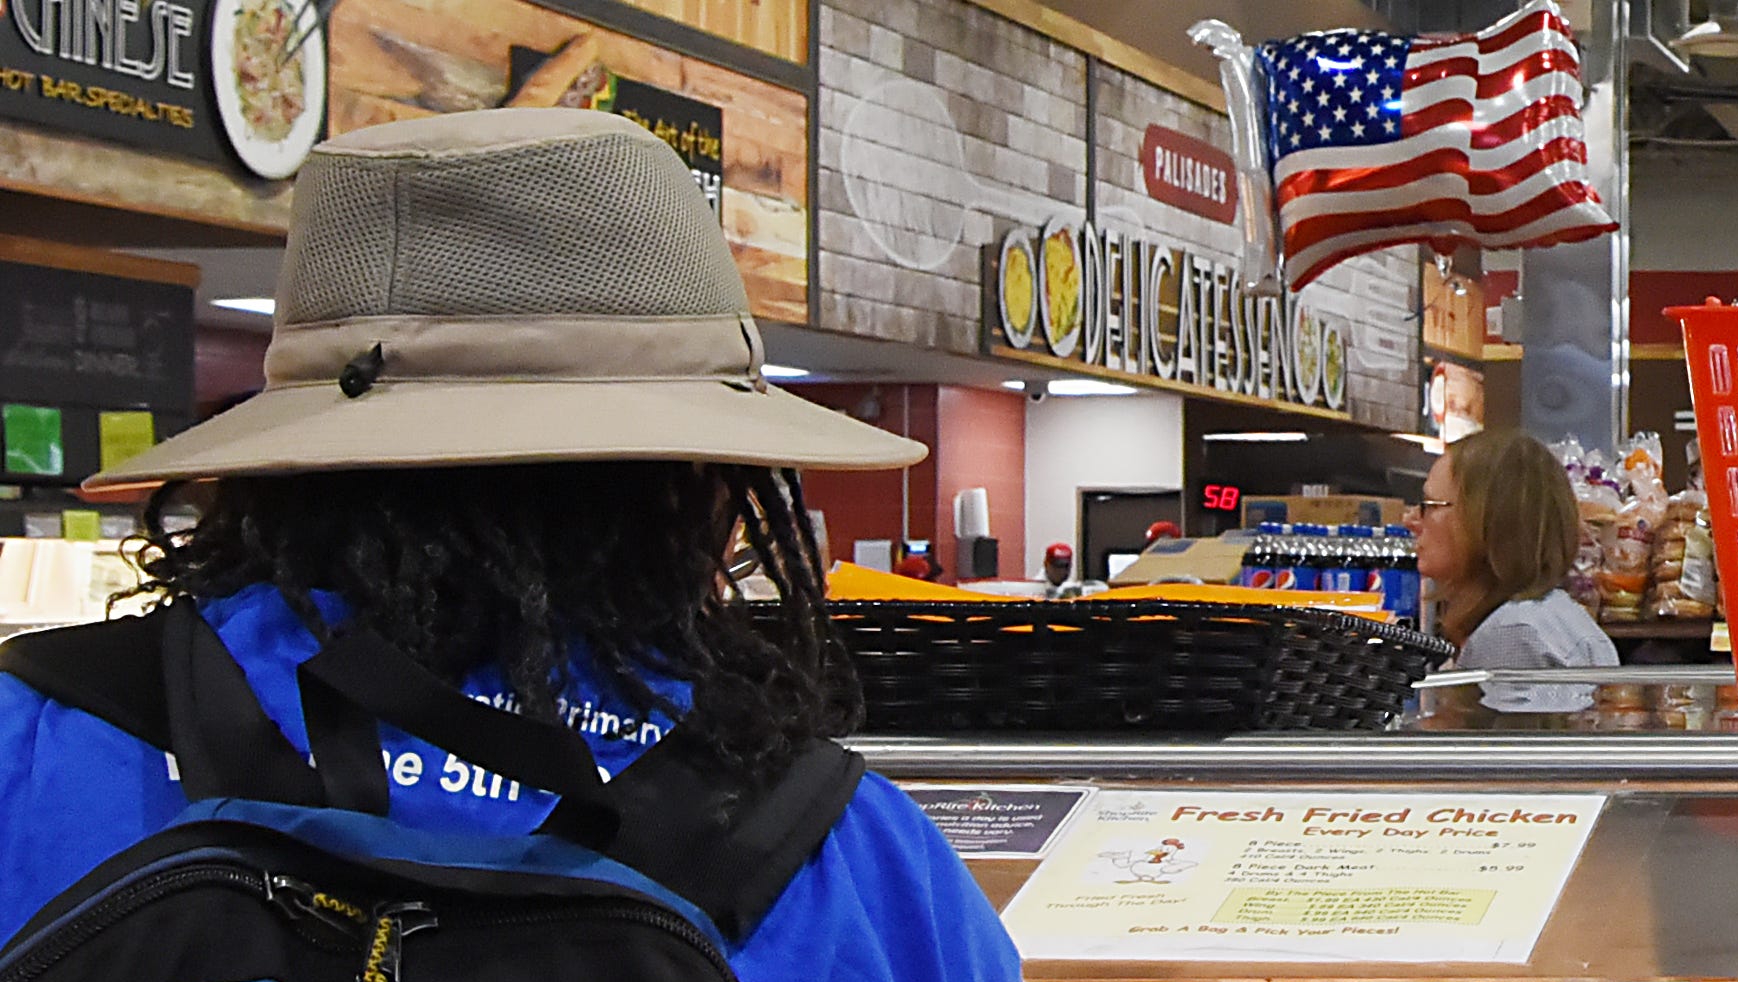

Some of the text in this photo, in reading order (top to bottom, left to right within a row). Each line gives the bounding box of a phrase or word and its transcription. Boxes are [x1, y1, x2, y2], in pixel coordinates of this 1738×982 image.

[1155, 145, 1226, 204] PALISADES
[1085, 221, 1298, 402] DELICATESSEN
[1204, 484, 1240, 511] 58
[1170, 806, 1578, 824] Fresh Fried Chicken
[1303, 826, 1499, 839] Every Day Price
[1198, 925, 1228, 934] Bag
[1255, 927, 1289, 935] Pick
[1341, 926, 1400, 934] Pieces!
